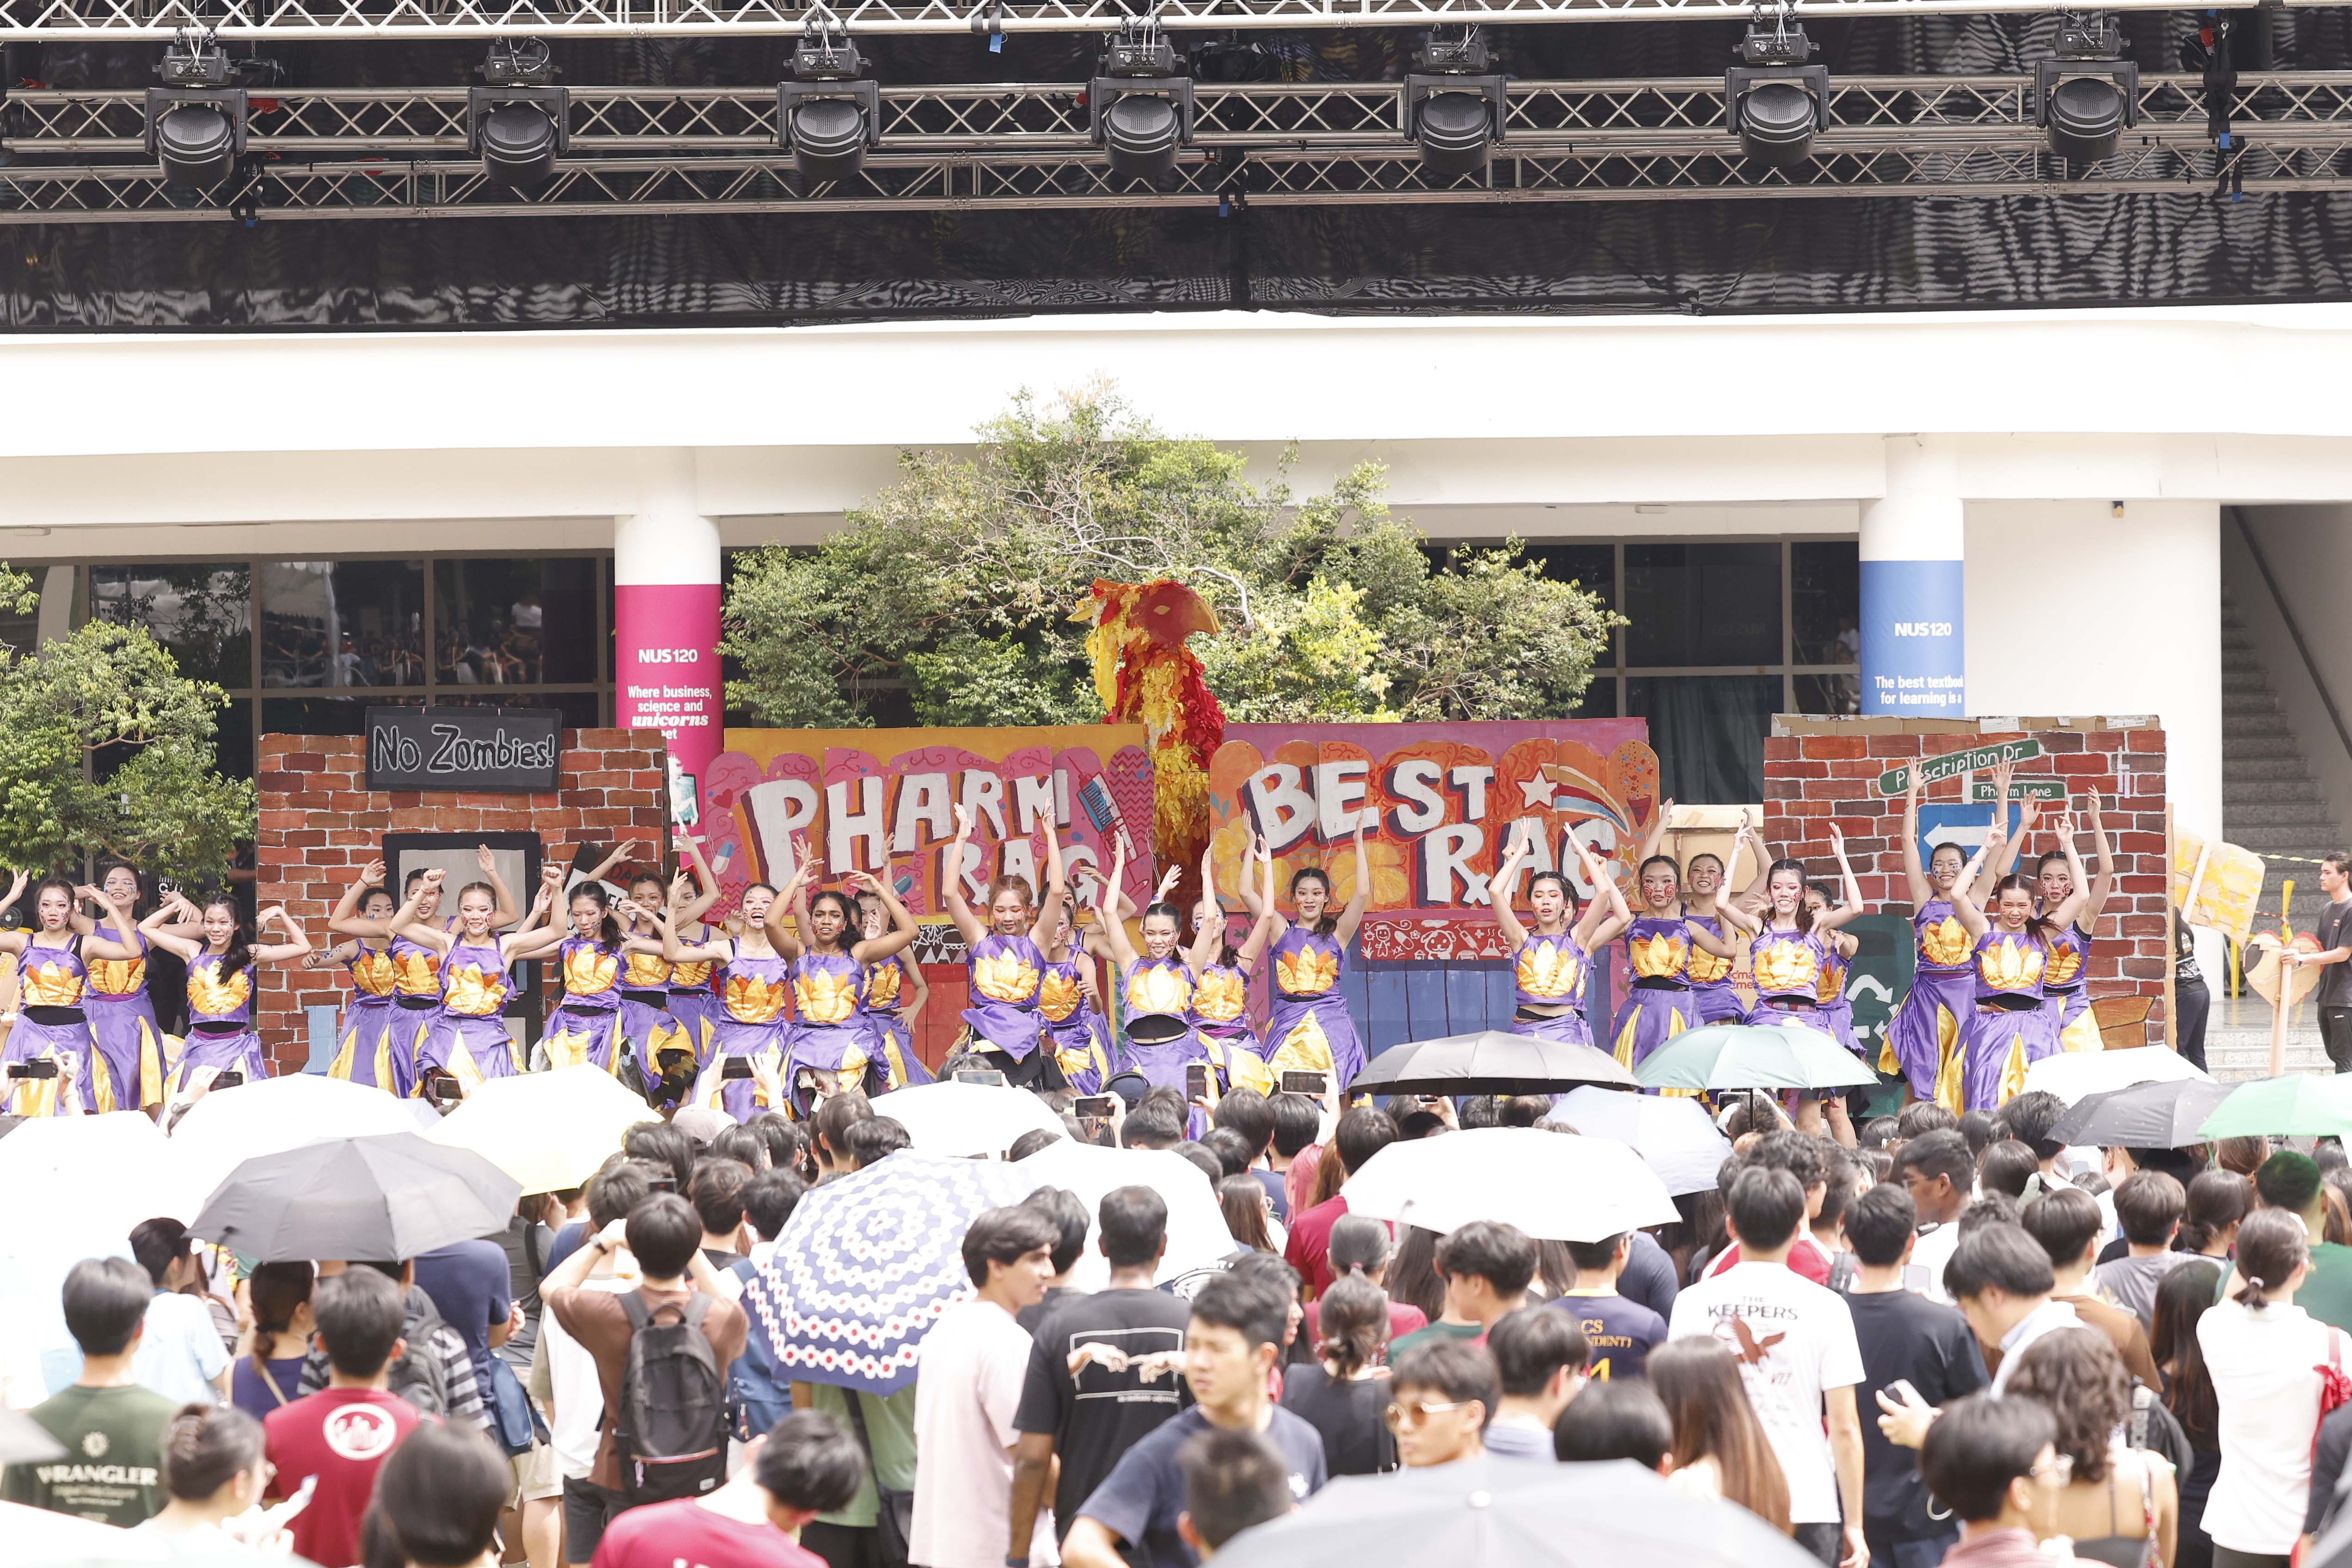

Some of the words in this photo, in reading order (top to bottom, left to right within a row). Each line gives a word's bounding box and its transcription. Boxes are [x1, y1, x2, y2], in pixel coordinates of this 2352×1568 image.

[1894, 623, 1952, 637] NUS120
[638, 649, 698, 663] NUS120
[1874, 675, 1895, 688] The
[1898, 675, 1924, 688] best
[627, 685, 660, 698] Where
[663, 685, 712, 699] business,
[1880, 691, 1896, 704] for
[1899, 691, 1947, 707] learning
[1948, 691, 1956, 704] is
[637, 699, 680, 712] science
[684, 699, 703, 711] and
[631, 712, 709, 727] unicorns
[373, 724, 422, 773] No
[427, 723, 555, 773] Zombies!
[2003, 745, 2023, 763] Dr
[1241, 760, 1494, 850] BEST
[748, 769, 1070, 892] PHARM
[1708, 1304, 1798, 1320] KEEPERS
[1581, 1319, 1604, 1334] CS
[37, 1464, 158, 1486] WRANGLER
